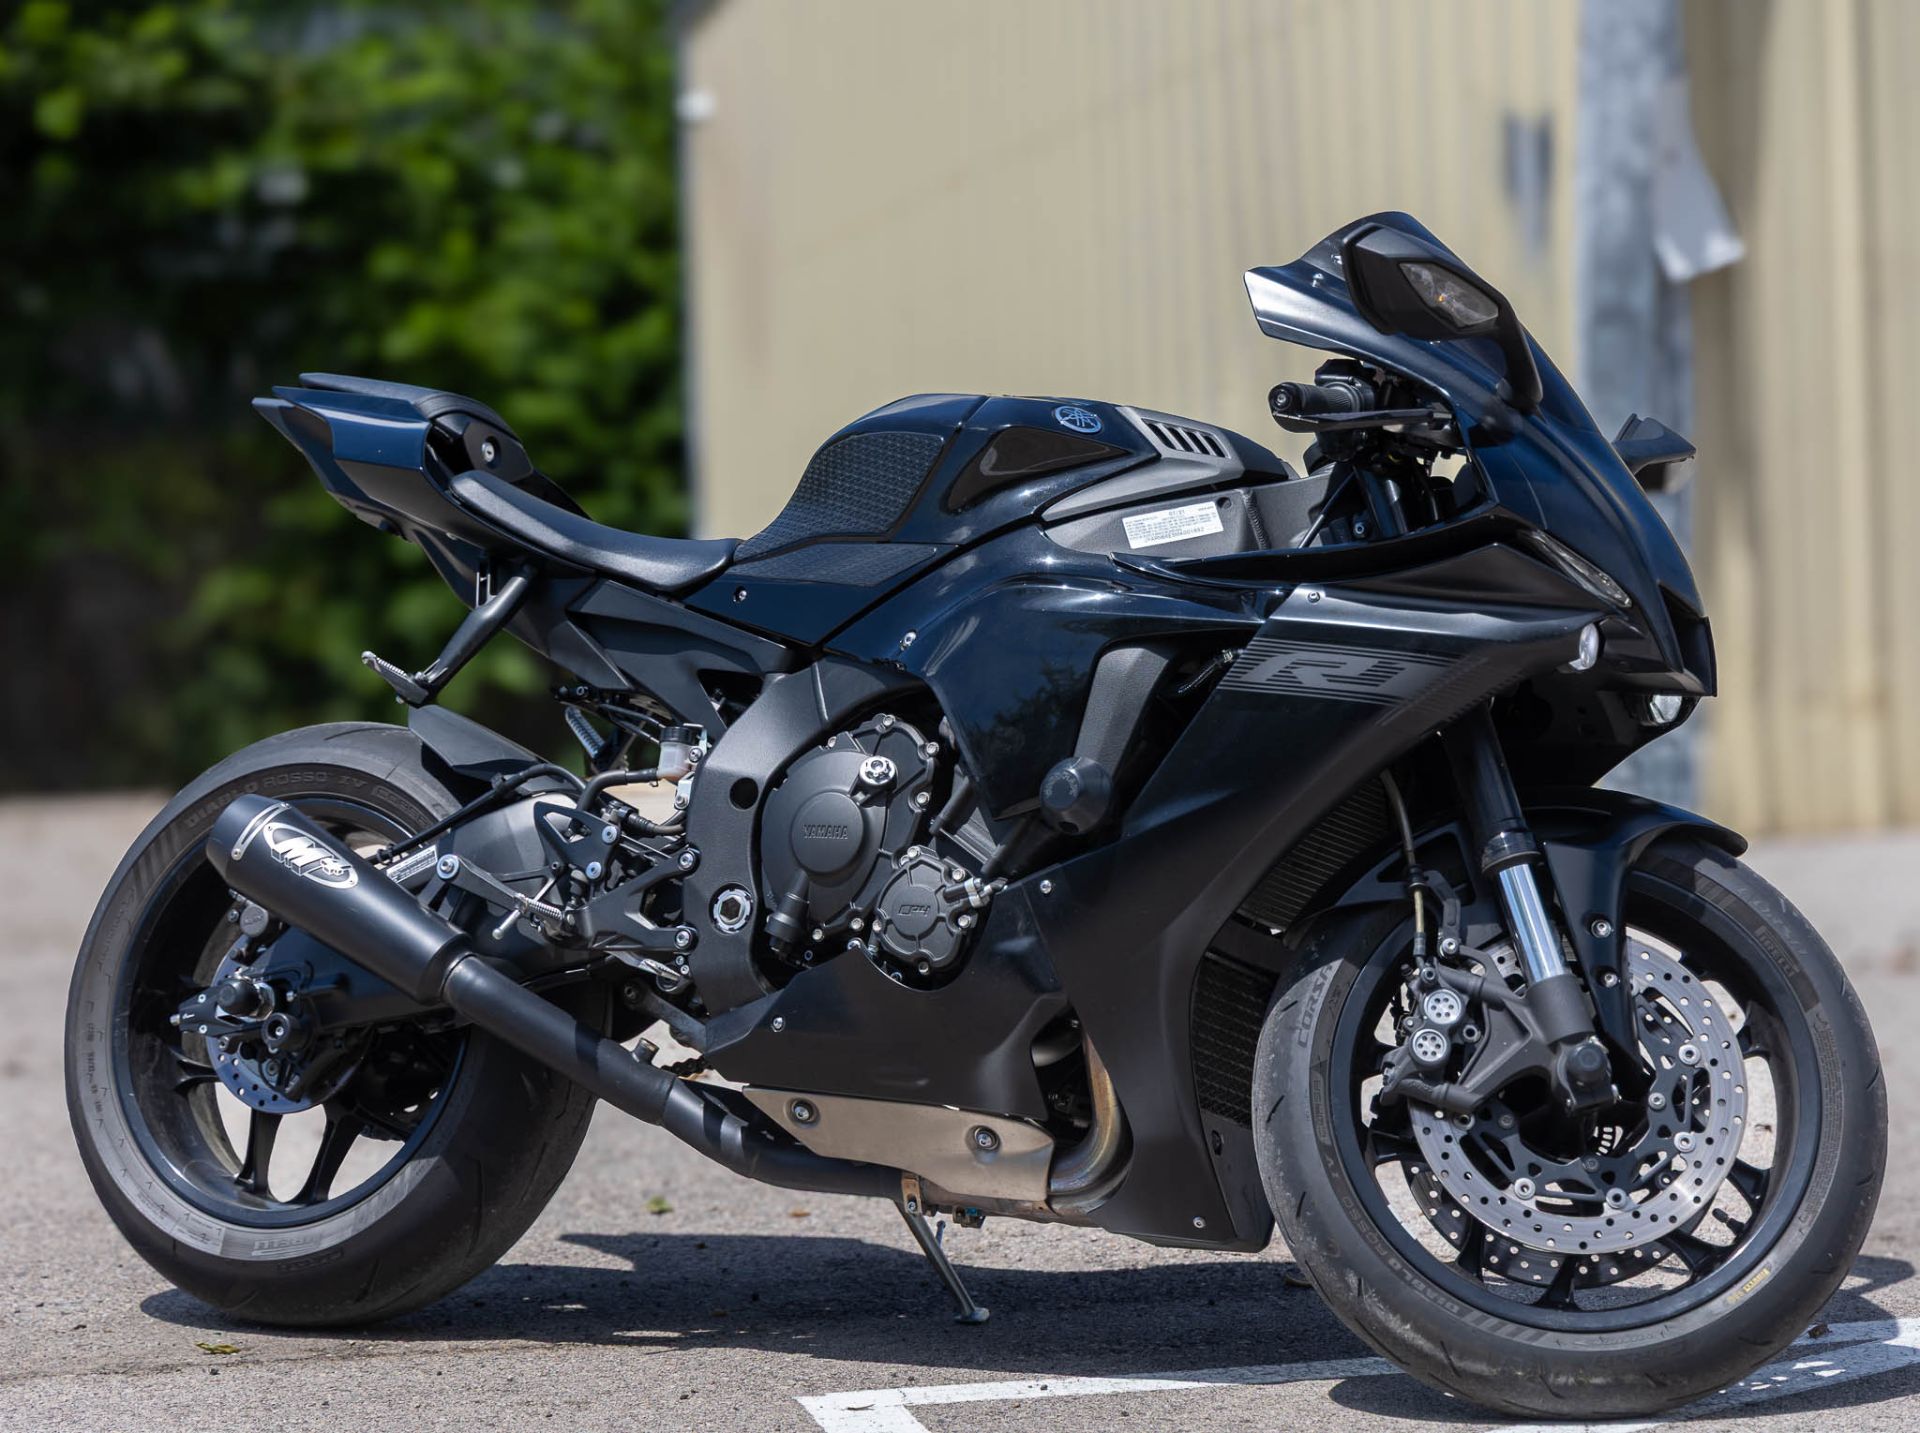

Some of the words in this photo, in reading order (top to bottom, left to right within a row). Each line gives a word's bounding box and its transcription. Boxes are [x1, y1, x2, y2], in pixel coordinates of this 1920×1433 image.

[1240, 651, 1448, 698] R1
[263, 771, 328, 788] ROSSO
[803, 824, 849, 839] YAMAHA
[1298, 965, 1333, 1048] CORSA
